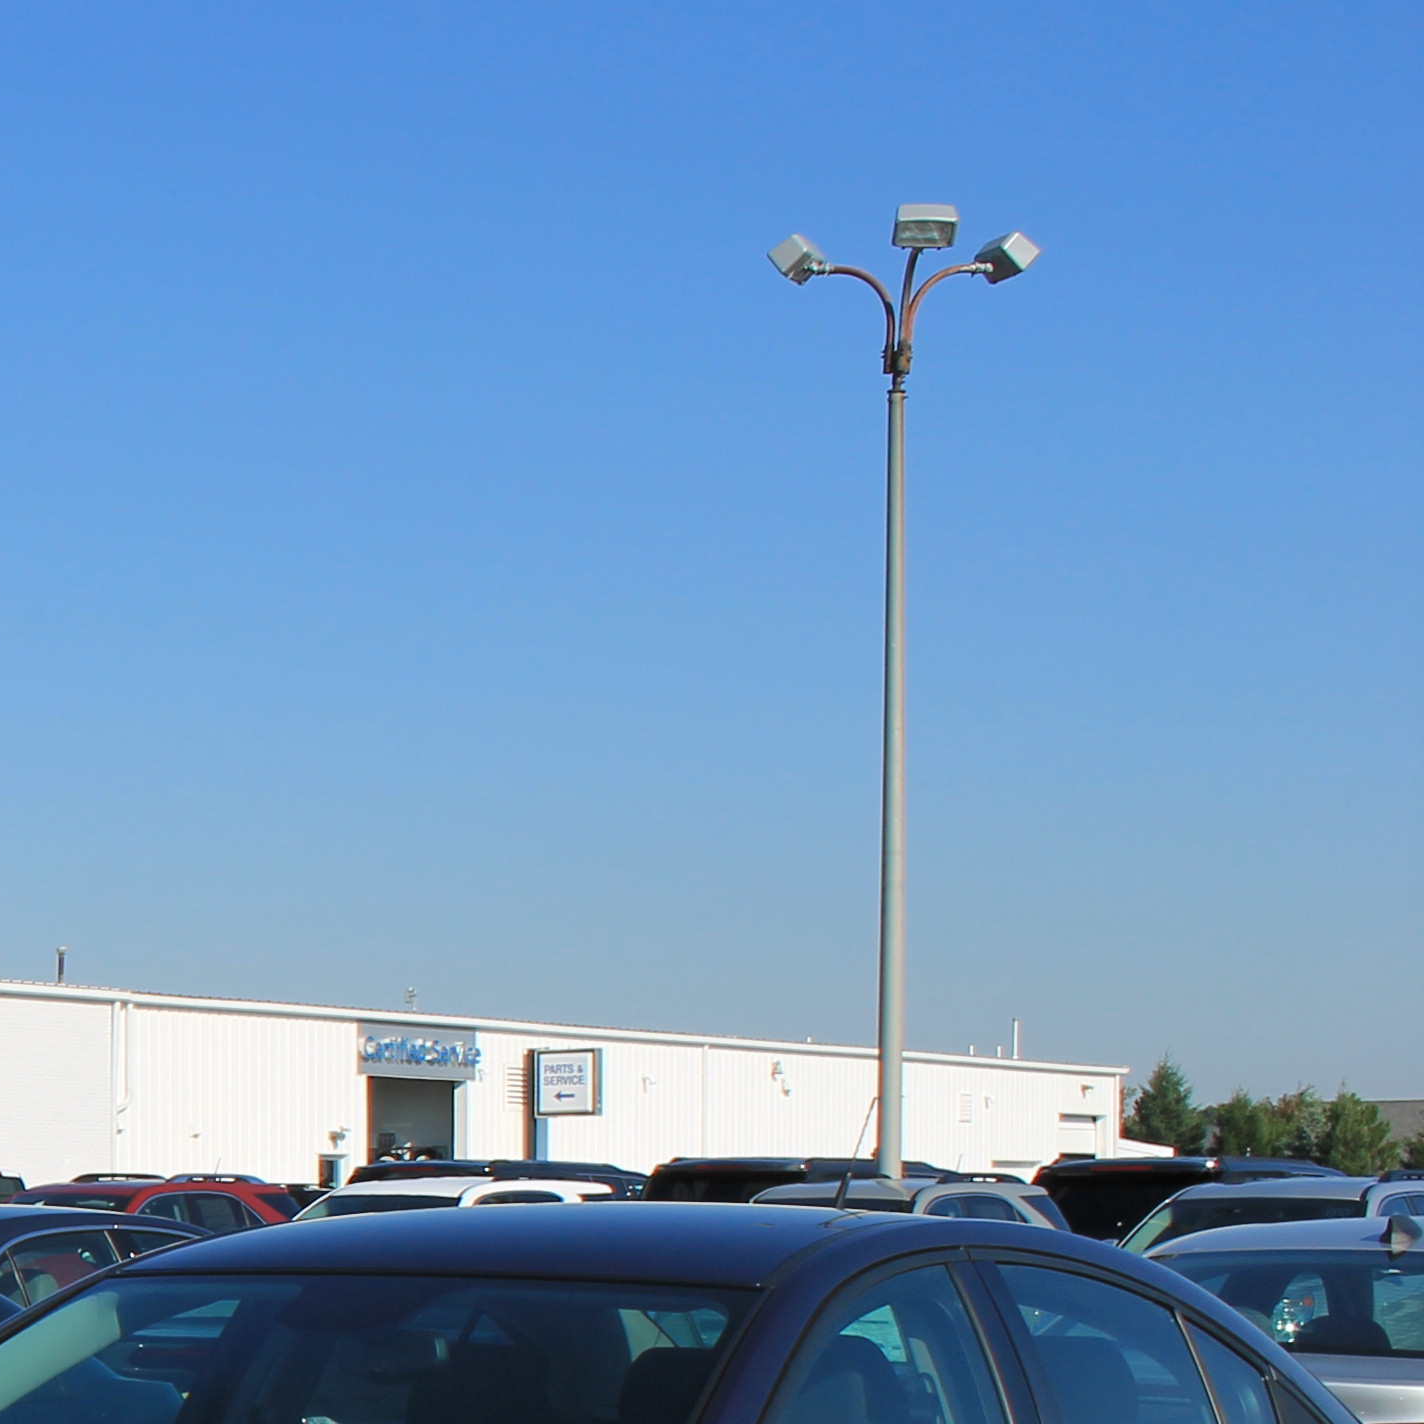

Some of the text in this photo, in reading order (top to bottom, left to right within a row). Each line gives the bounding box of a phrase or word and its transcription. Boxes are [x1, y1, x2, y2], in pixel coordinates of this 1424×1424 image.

[360, 1035, 482, 1065] Certified Service
[543, 1064, 574, 1074] PARTS
[543, 1075, 585, 1086] SERVICE
